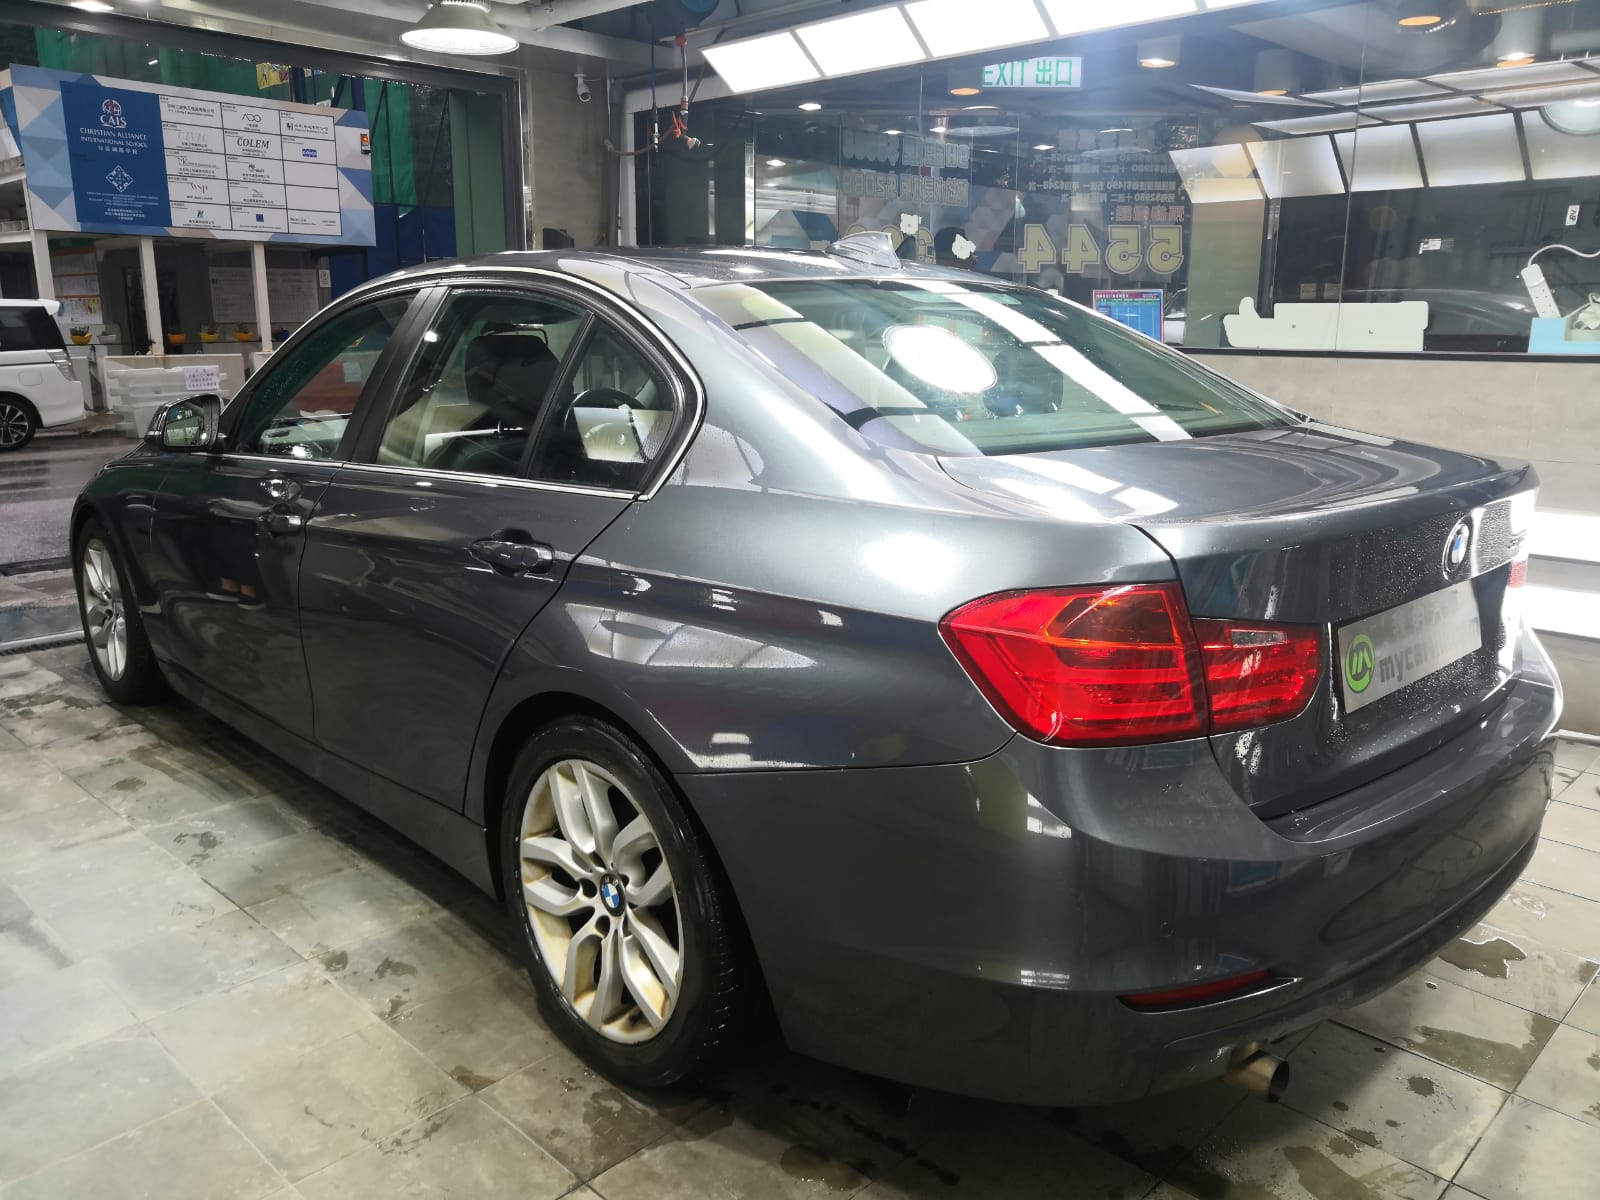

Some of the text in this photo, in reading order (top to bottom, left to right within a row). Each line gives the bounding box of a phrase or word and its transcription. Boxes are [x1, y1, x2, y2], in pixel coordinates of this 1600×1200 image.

[982, 59, 1073, 86] EXIT 出口
[100, 114, 128, 127] CAIS
[80, 127, 147, 141] CHRISTIAN ALLIANCE
[80, 136, 148, 149] INTERNATIONAL SCHOOL
[237, 137, 270, 149] COLEM
